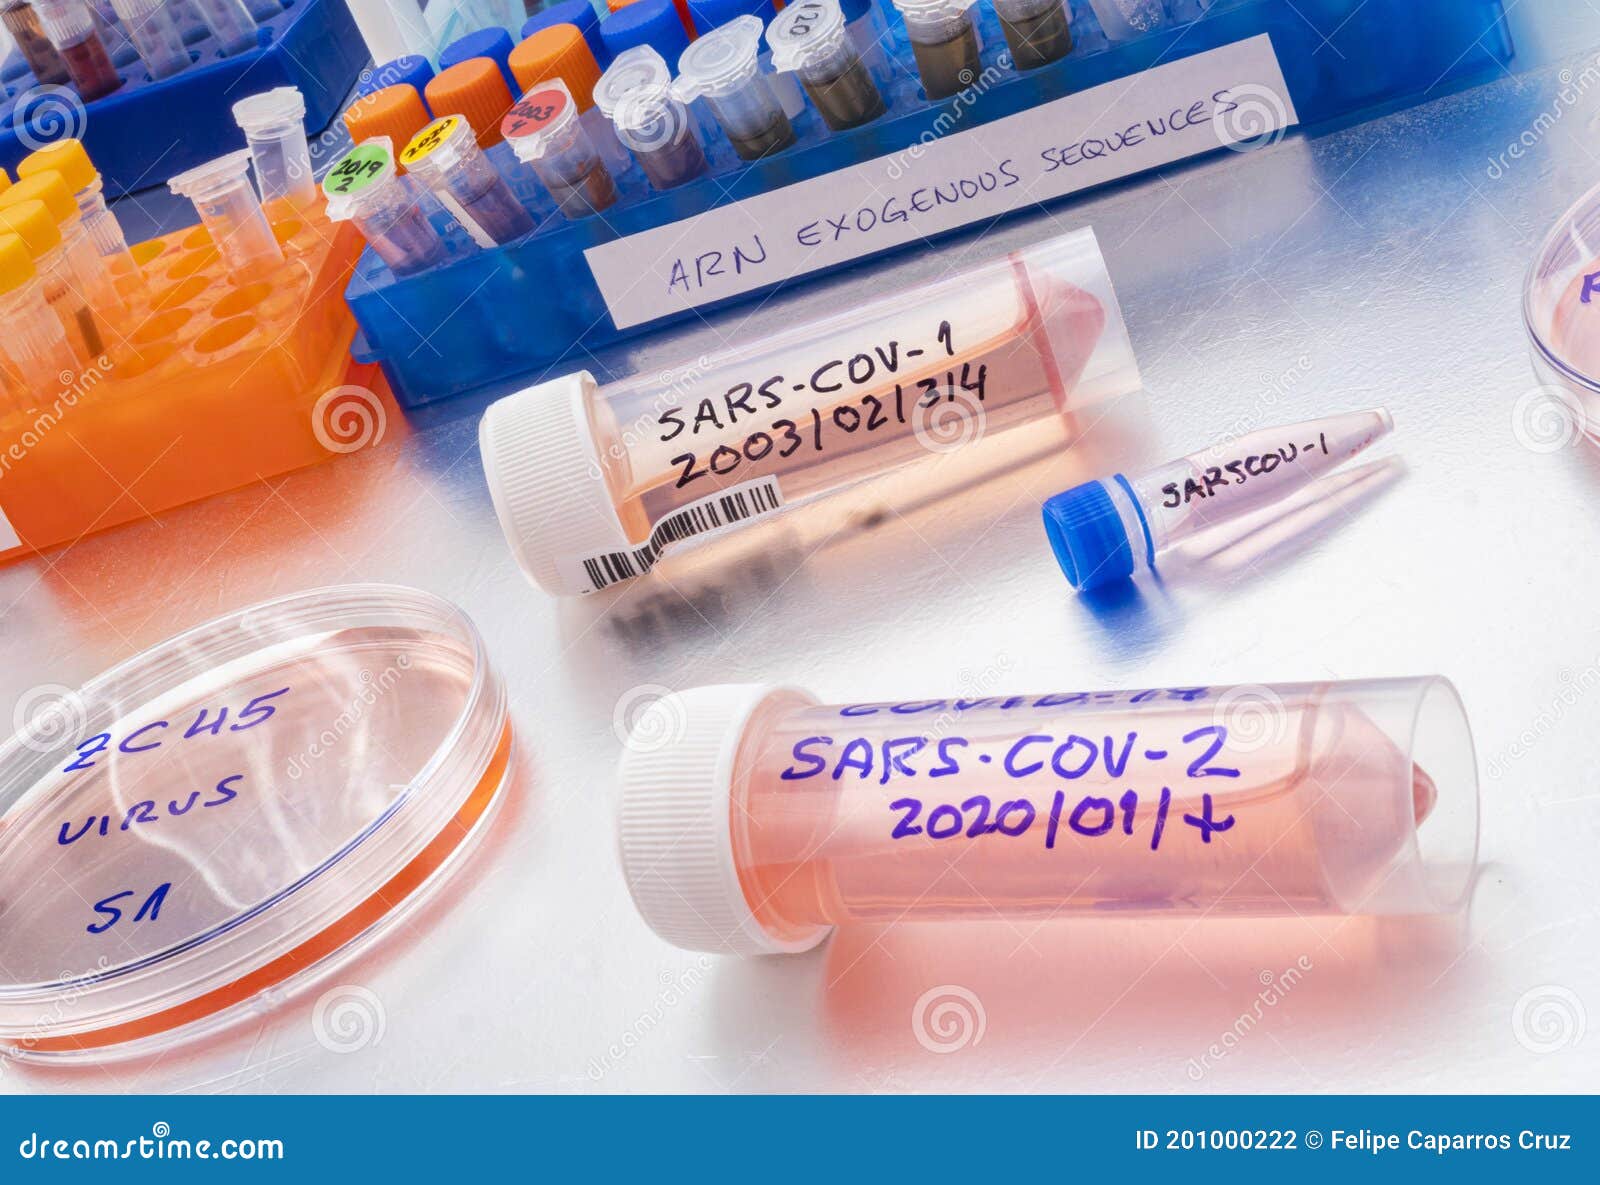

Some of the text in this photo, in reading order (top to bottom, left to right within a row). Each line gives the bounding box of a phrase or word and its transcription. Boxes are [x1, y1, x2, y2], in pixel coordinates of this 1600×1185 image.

[331, 158, 385, 178] 2019
[667, 89, 1240, 294] ARN EXOGENOUS SEQUENCES
